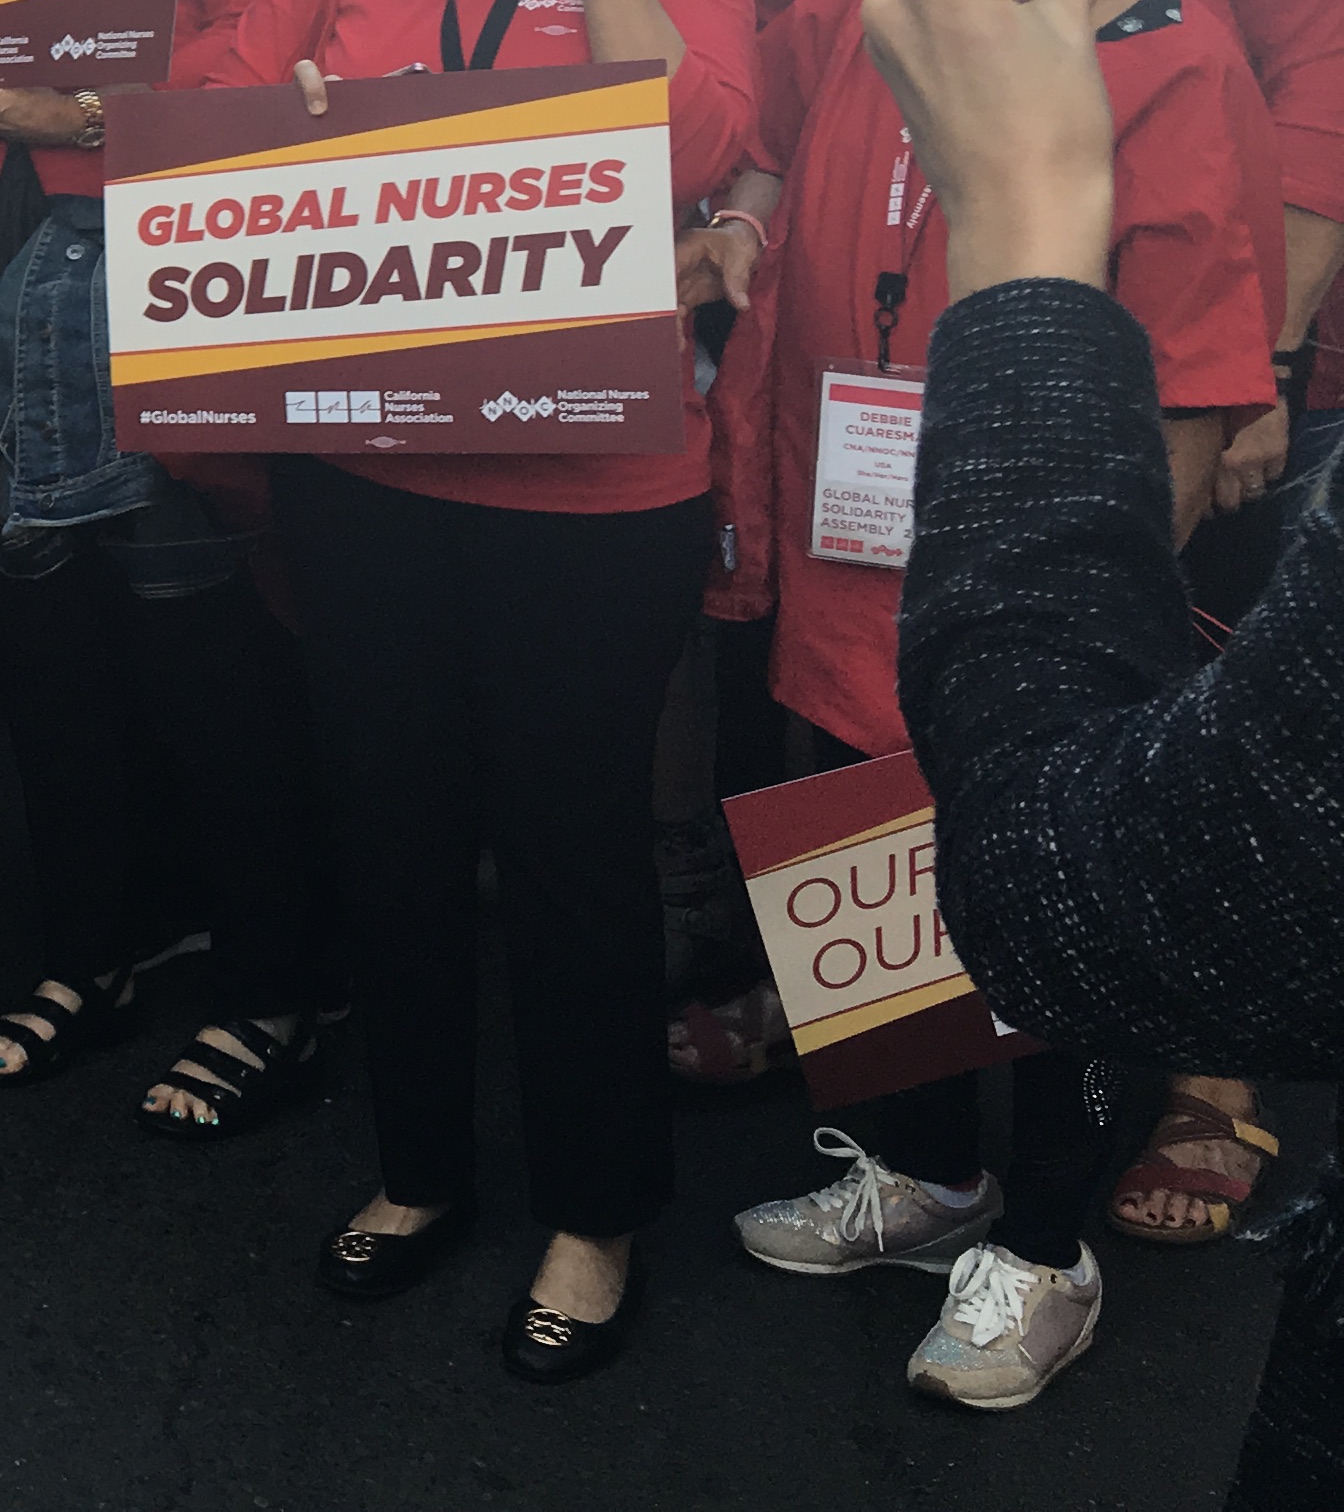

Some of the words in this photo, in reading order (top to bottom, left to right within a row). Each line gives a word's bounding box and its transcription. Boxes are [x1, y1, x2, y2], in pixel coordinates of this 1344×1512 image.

[137, 186, 360, 247] GLOBAL
[375, 158, 627, 224] NURSES
[142, 225, 633, 322] SOLIDARITY
[384, 391, 441, 401] California
[557, 390, 607, 400] National
[608, 390, 650, 400] Nurses
[384, 402, 424, 412] Nurses
[557, 401, 624, 413] Organizing
[140, 410, 257, 424] #GlobalNurses
[385, 413, 454, 423] Association
[558, 412, 625, 423] Committee
[860, 411, 912, 427] DEBBIE
[822, 488, 879, 505] GLOBAL
[822, 503, 906, 523] SOLIDARITY
[820, 518, 894, 536] ASSEMBLY
